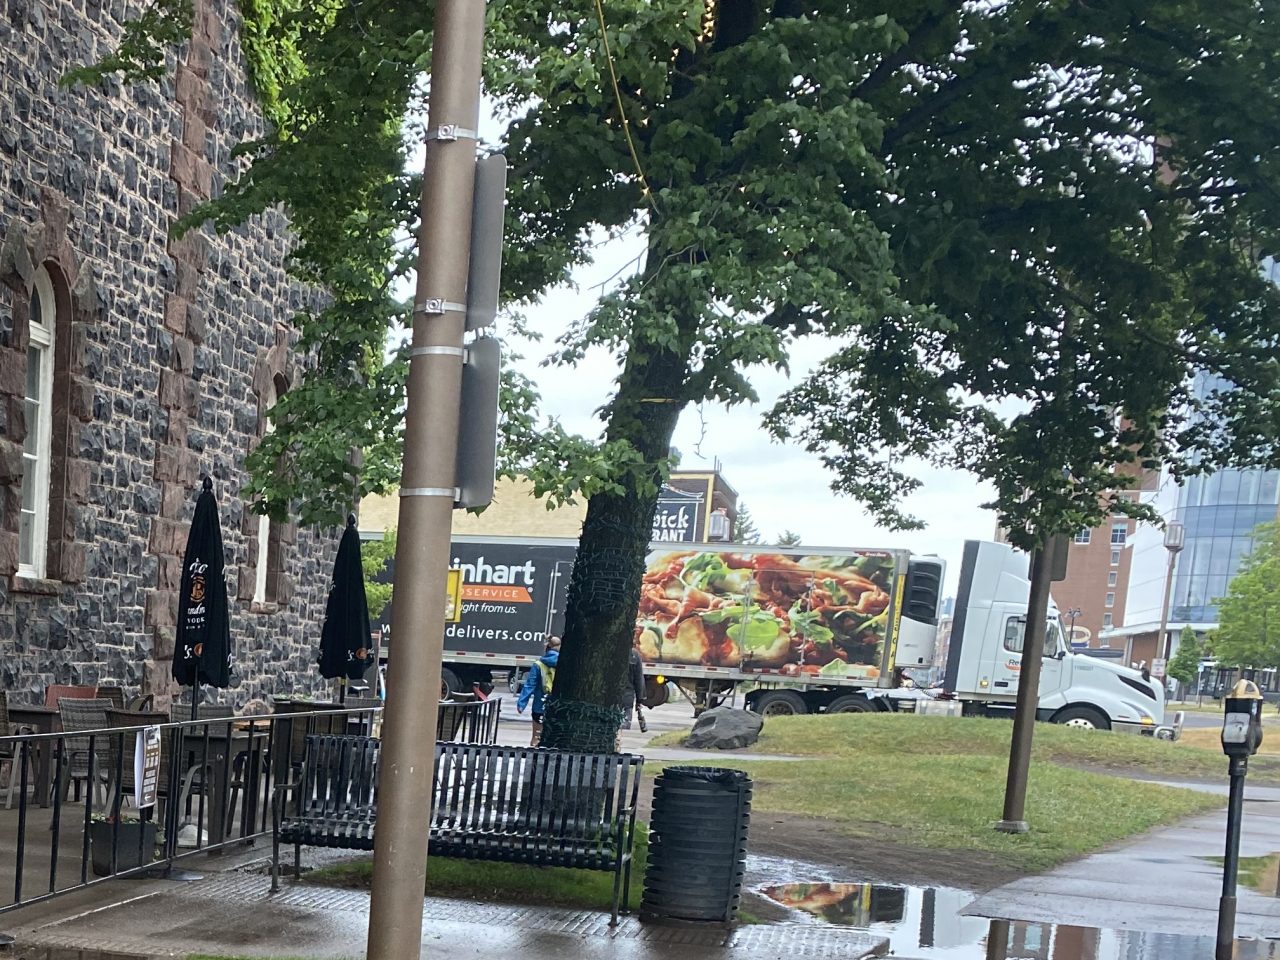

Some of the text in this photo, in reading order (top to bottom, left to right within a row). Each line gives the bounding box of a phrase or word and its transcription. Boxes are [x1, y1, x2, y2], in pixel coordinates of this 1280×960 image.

[448, 556, 536, 585] inhart
[480, 602, 504, 613] from
[504, 605, 518, 614] us.
